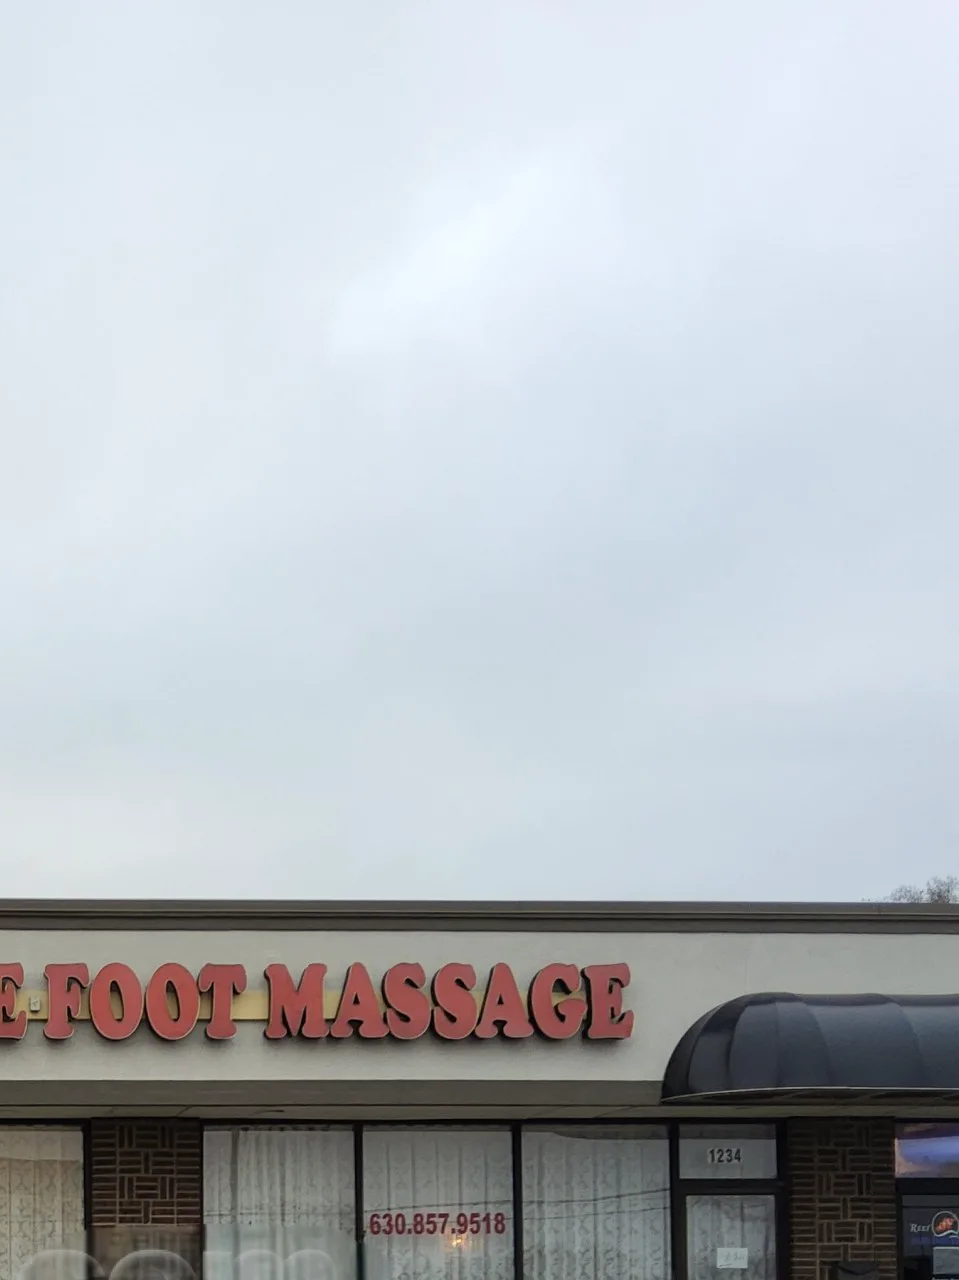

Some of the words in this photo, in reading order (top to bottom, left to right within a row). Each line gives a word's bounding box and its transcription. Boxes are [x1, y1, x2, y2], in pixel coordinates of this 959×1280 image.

[42, 961, 247, 1042] FOOT
[263, 961, 636, 1041] MASSAGE
[708, 1148, 742, 1163] 1234
[369, 1211, 507, 1236] 630.857.9518
